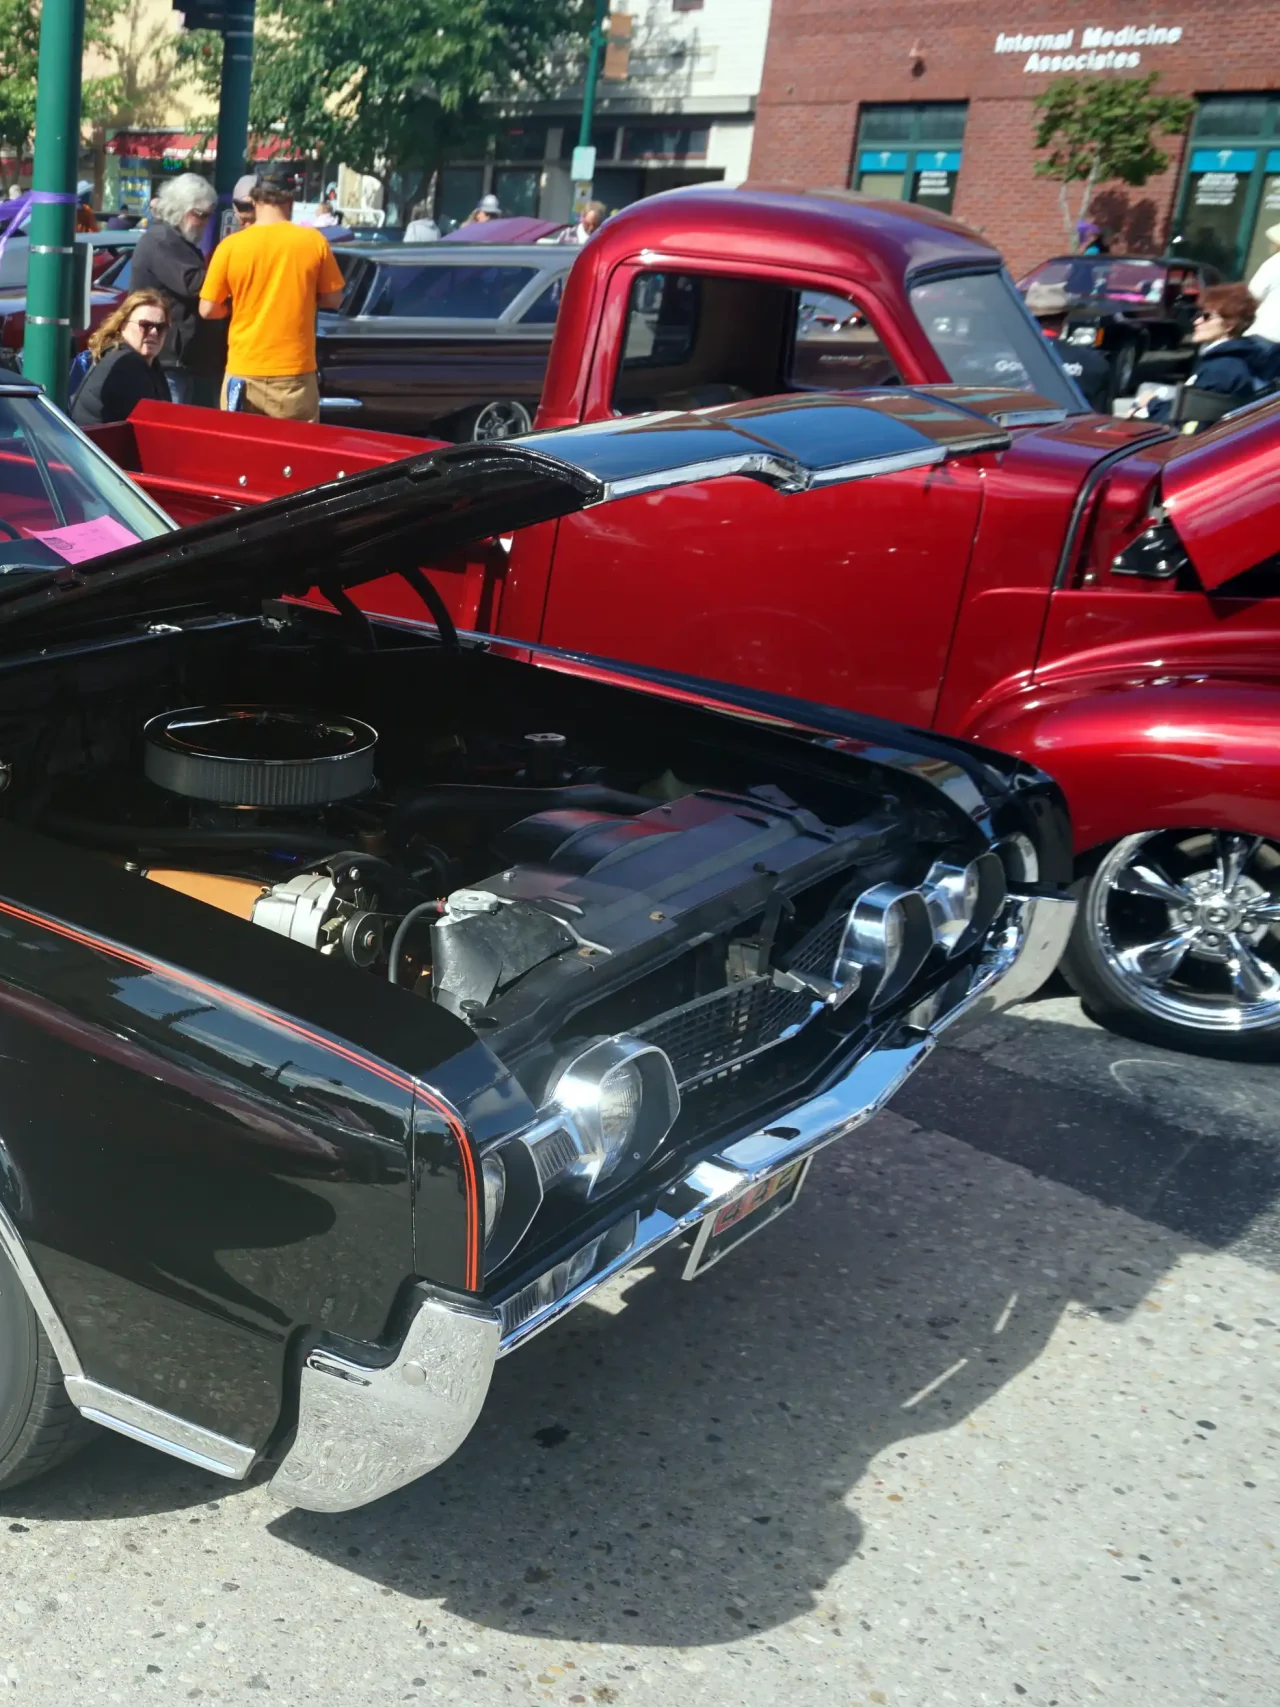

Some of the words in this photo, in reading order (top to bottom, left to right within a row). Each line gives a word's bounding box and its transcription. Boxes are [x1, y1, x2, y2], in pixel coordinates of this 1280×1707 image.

[994, 28, 1075, 53] Internal
[1080, 24, 1183, 49] Medicine
[1023, 50, 1141, 73] Associates
